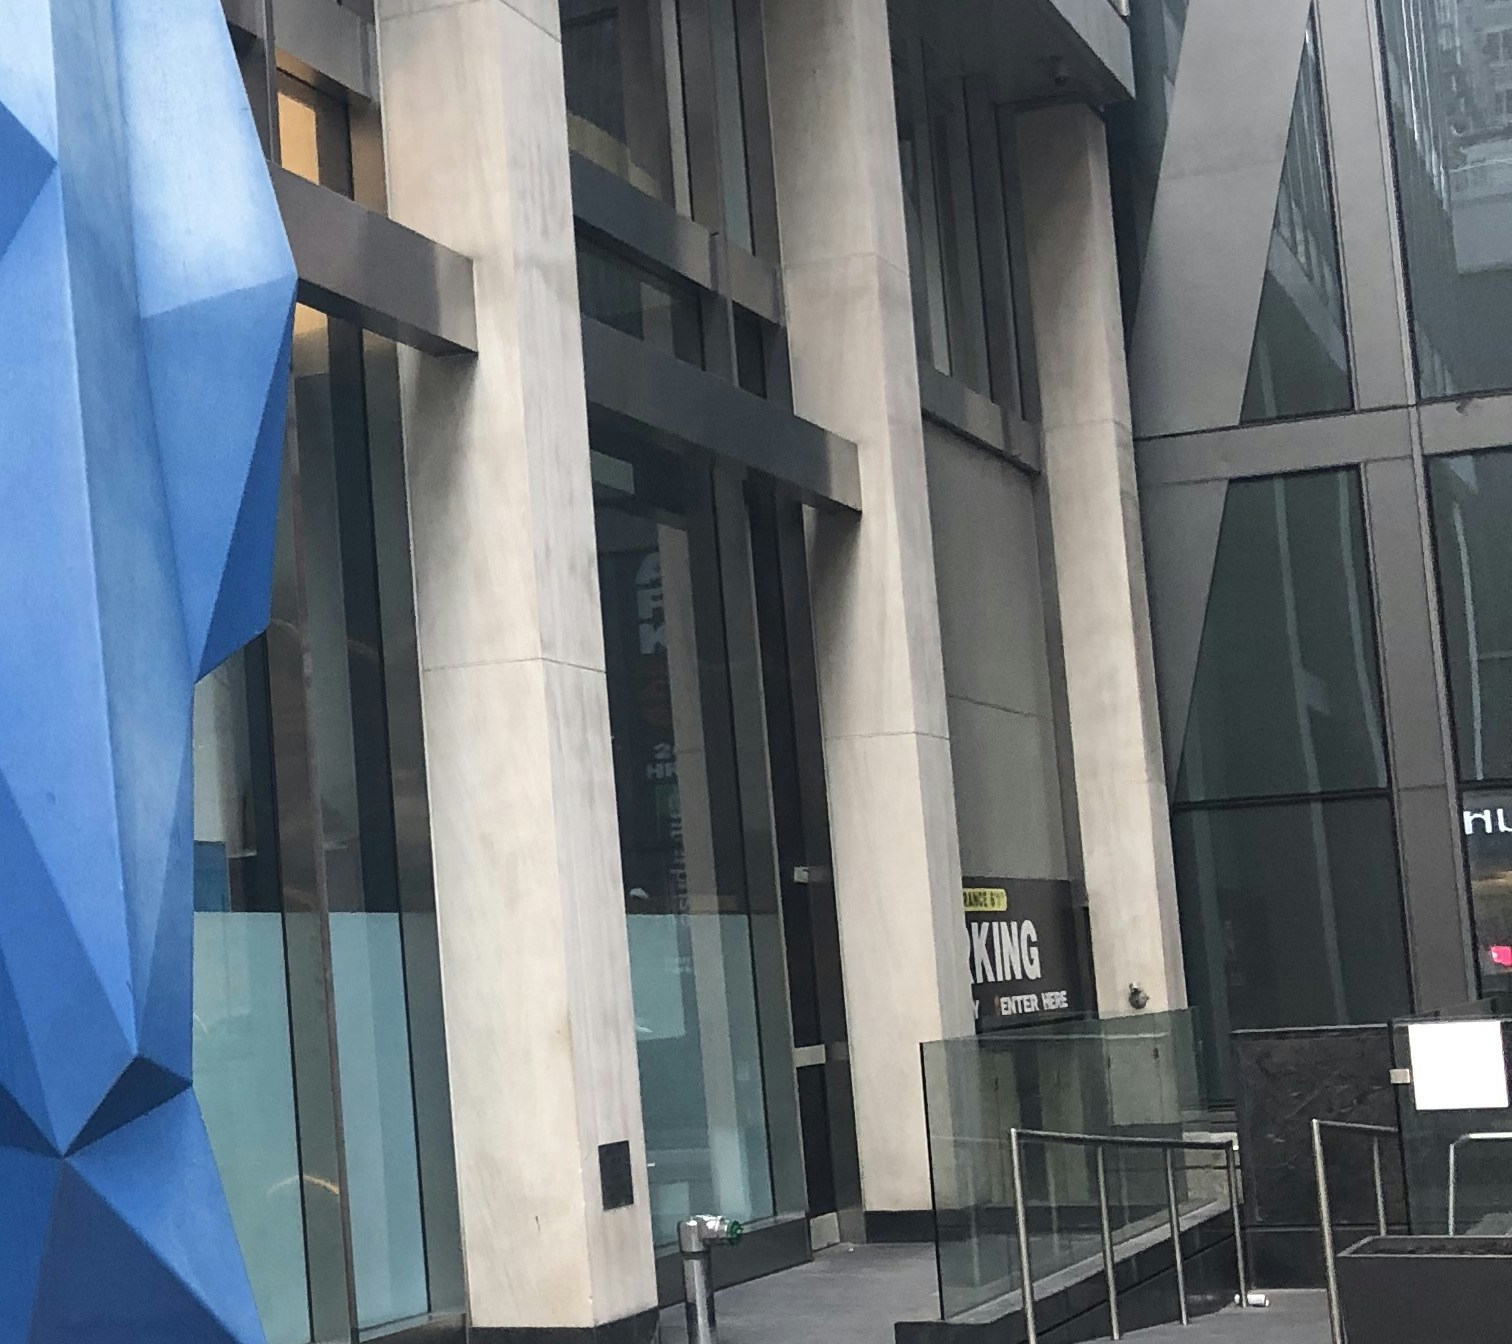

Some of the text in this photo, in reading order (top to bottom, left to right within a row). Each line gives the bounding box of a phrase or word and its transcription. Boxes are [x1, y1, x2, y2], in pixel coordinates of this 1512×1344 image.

[969, 919, 1042, 984] KING
[1000, 994, 1040, 1016] ENTER
[1041, 990, 1069, 1011] HERE
